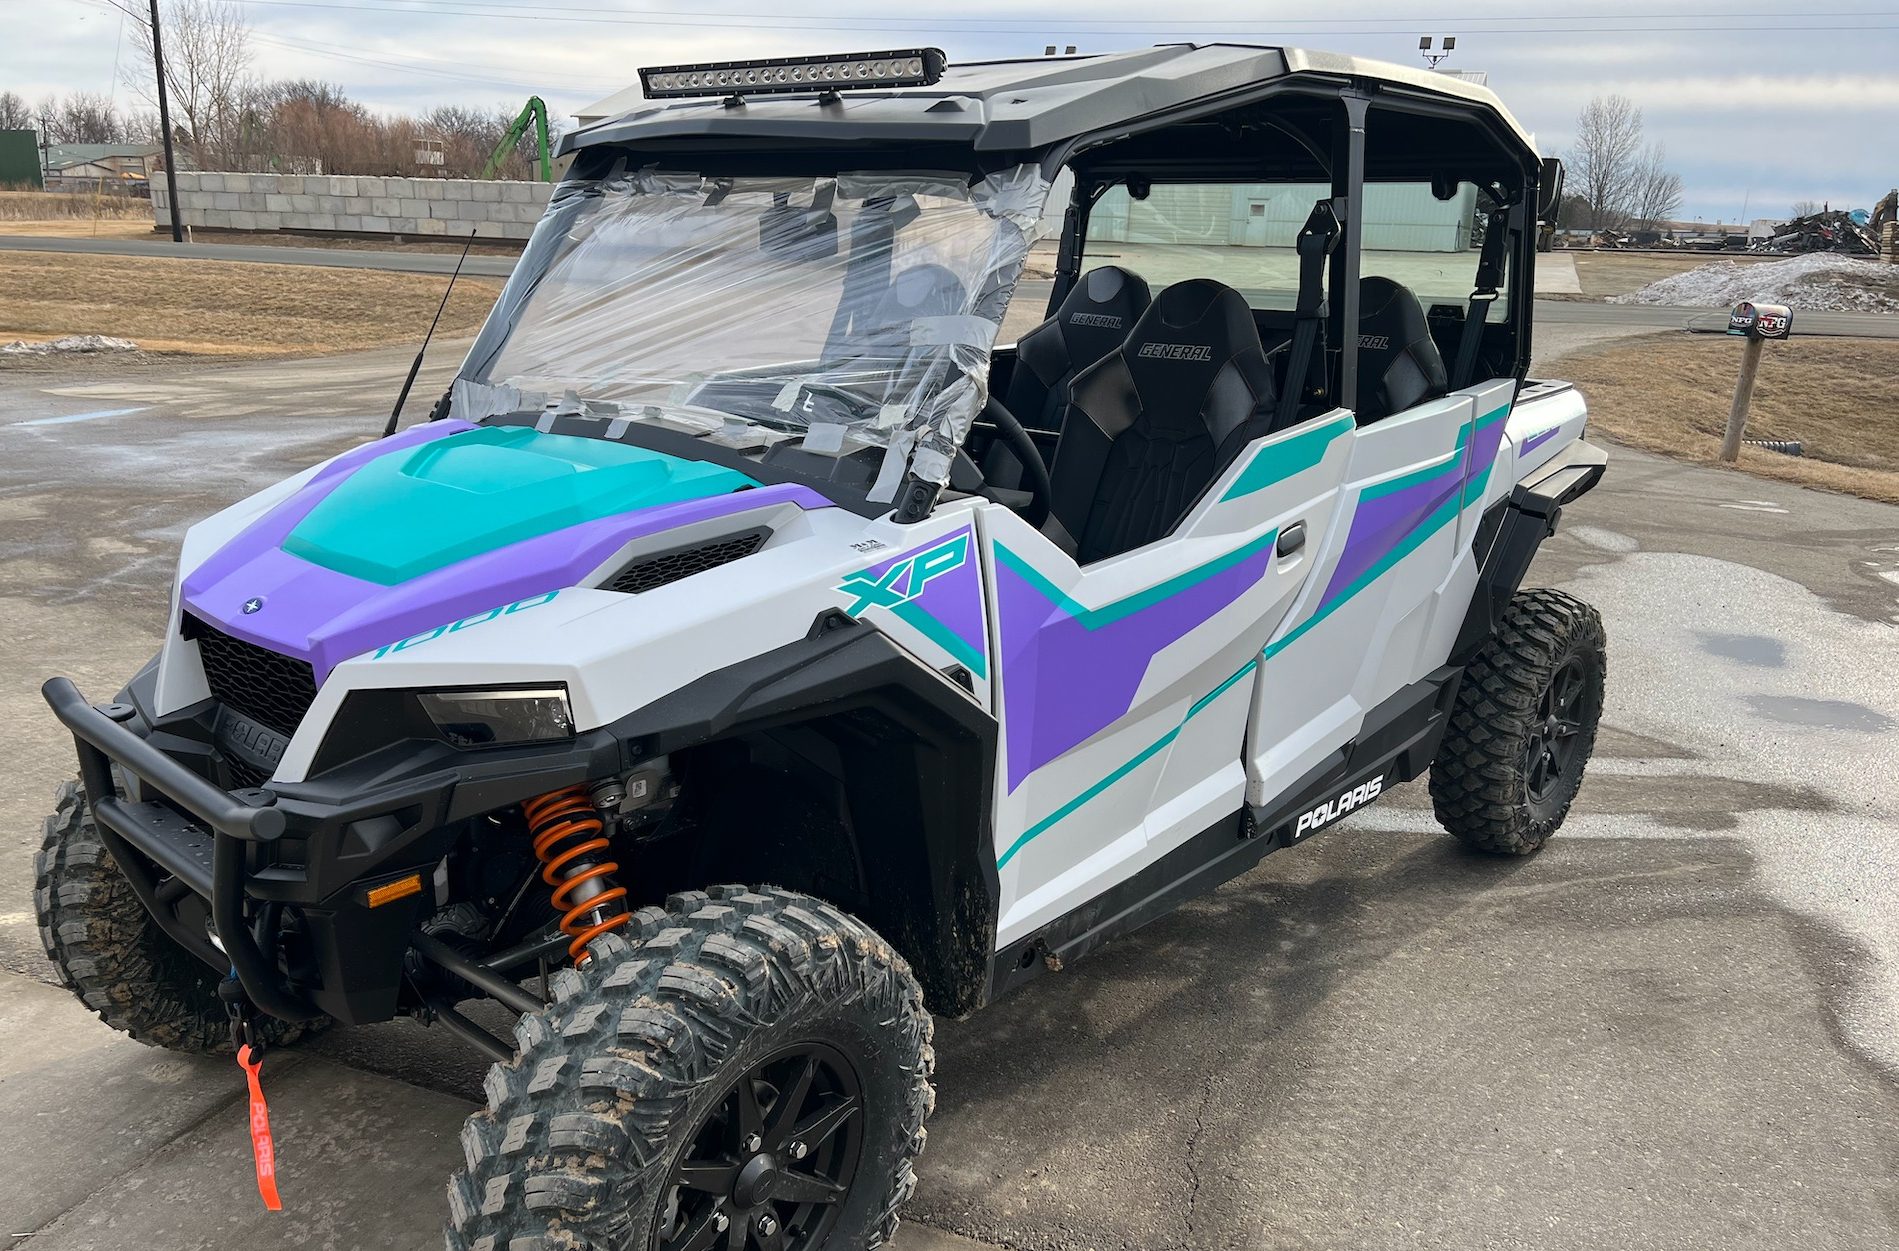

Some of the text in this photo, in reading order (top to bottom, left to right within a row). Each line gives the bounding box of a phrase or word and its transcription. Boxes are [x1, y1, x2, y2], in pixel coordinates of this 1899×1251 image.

[1069, 312, 1123, 329] GENERAL
[1138, 342, 1212, 361] GENERAL
[830, 531, 971, 618] XP
[1294, 774, 1384, 838] POLARIS
[252, 1102, 273, 1177] POLARIS
